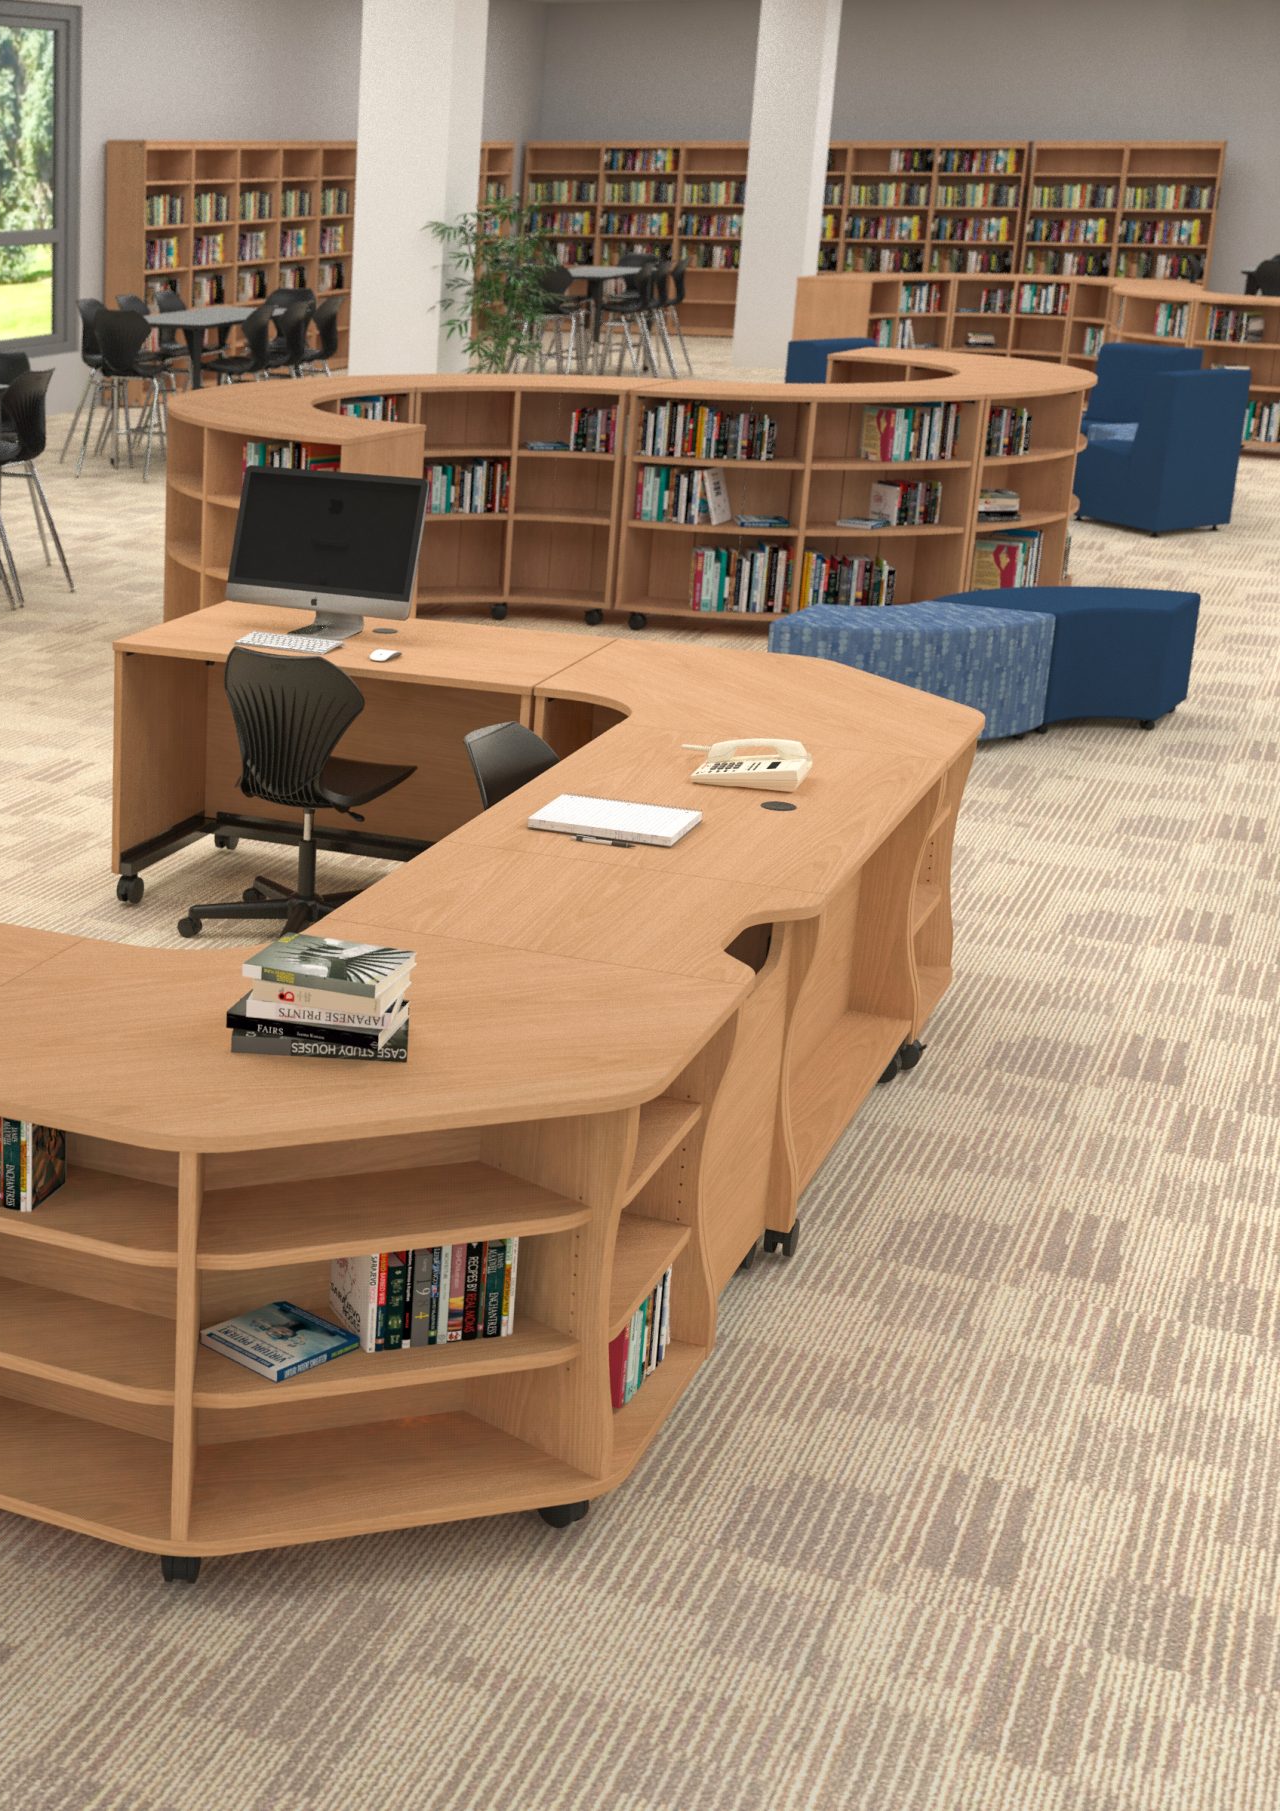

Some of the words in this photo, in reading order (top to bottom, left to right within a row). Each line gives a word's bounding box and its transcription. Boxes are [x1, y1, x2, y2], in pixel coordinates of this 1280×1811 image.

[278, 1007, 322, 1020] PRINTS
[325, 1011, 385, 1027] JAPANESE
[257, 1023, 284, 1036] FAIRS
[291, 1042, 337, 1056] HOUSES
[338, 1044, 375, 1059] STUDY
[376, 1047, 408, 1060] CASE
[5, 1163, 16, 1207] ENCHANTRESS
[369, 1256, 378, 1287] SARAJEVO
[466, 1256, 479, 1283] RECIPES
[466, 1283, 477, 1292] BY
[465, 1293, 477, 1309] REAL
[463, 1310, 476, 1333] MOMS
[487, 1292, 499, 1335] ENCHANTRESS
[218, 1327, 251, 1346] PATIENT
[251, 1343, 287, 1364] VIRTUAL
